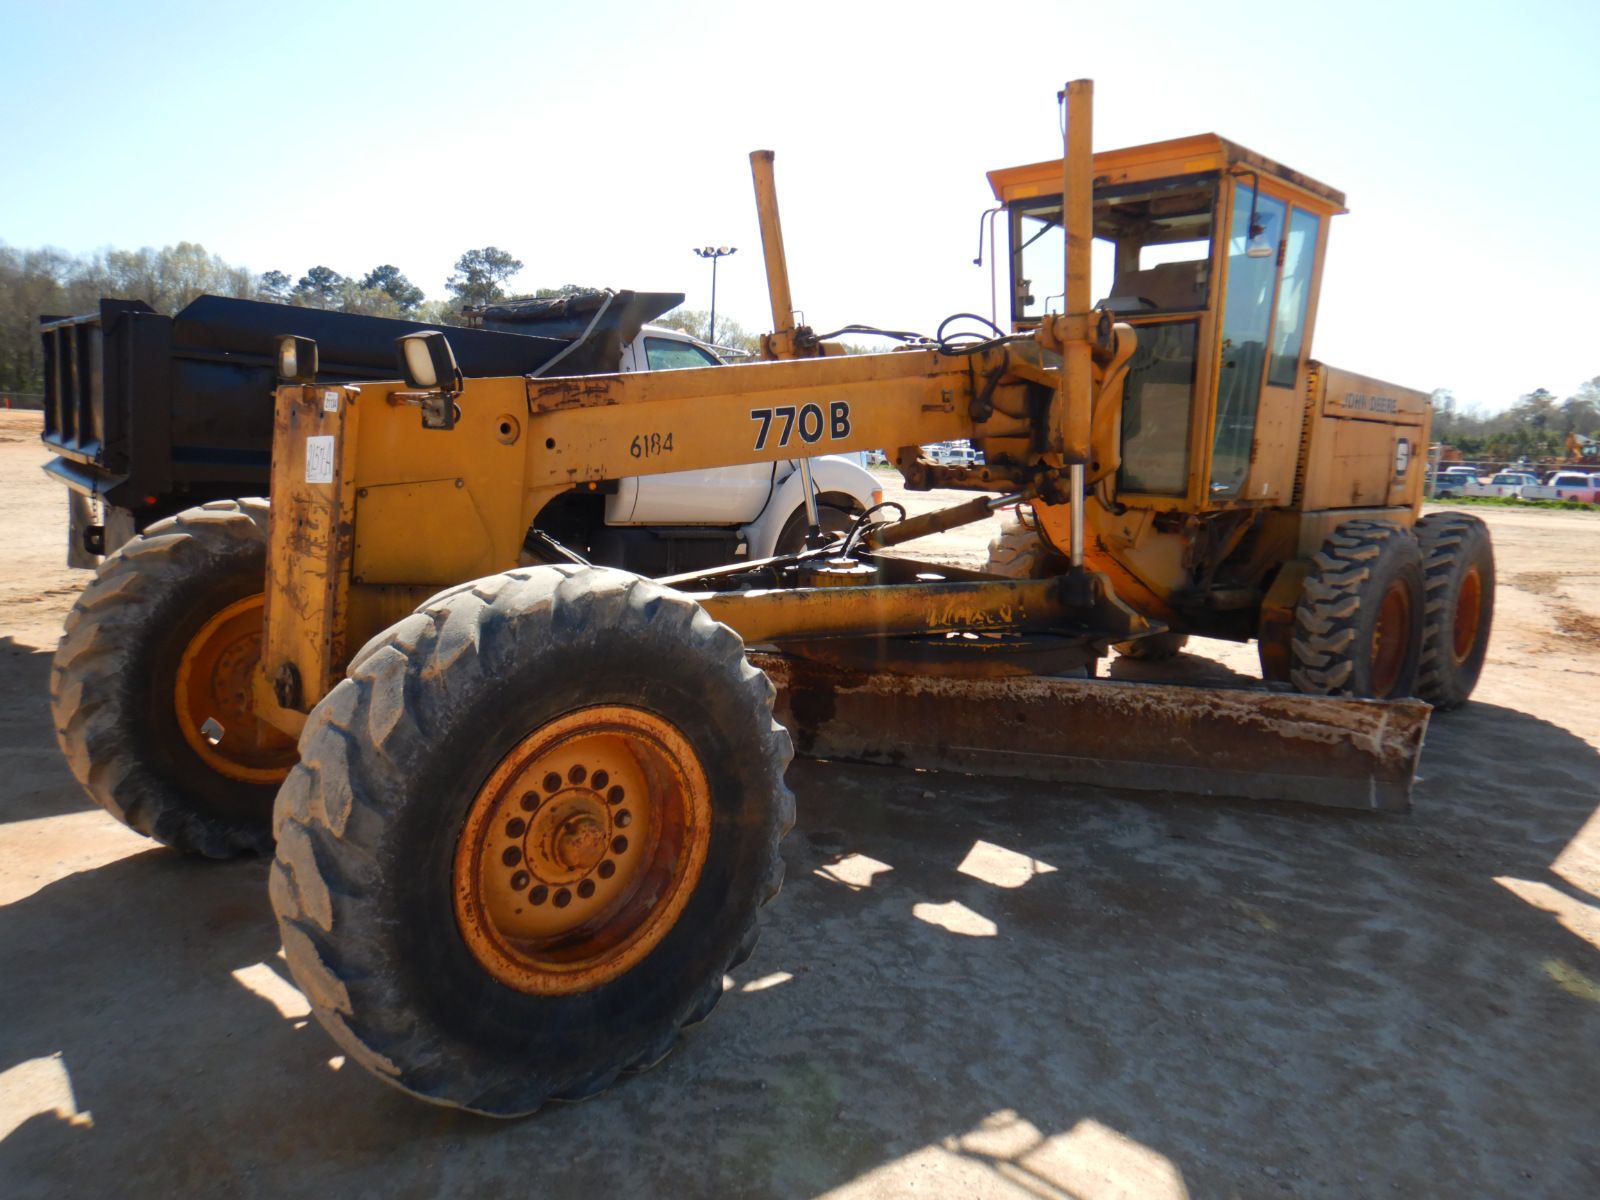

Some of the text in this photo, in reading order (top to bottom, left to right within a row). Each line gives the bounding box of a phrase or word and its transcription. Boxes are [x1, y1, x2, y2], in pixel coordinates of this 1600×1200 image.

[1341, 393, 1397, 414] JOHN DEERE
[750, 400, 851, 451] 770B
[630, 432, 674, 459] 6184
